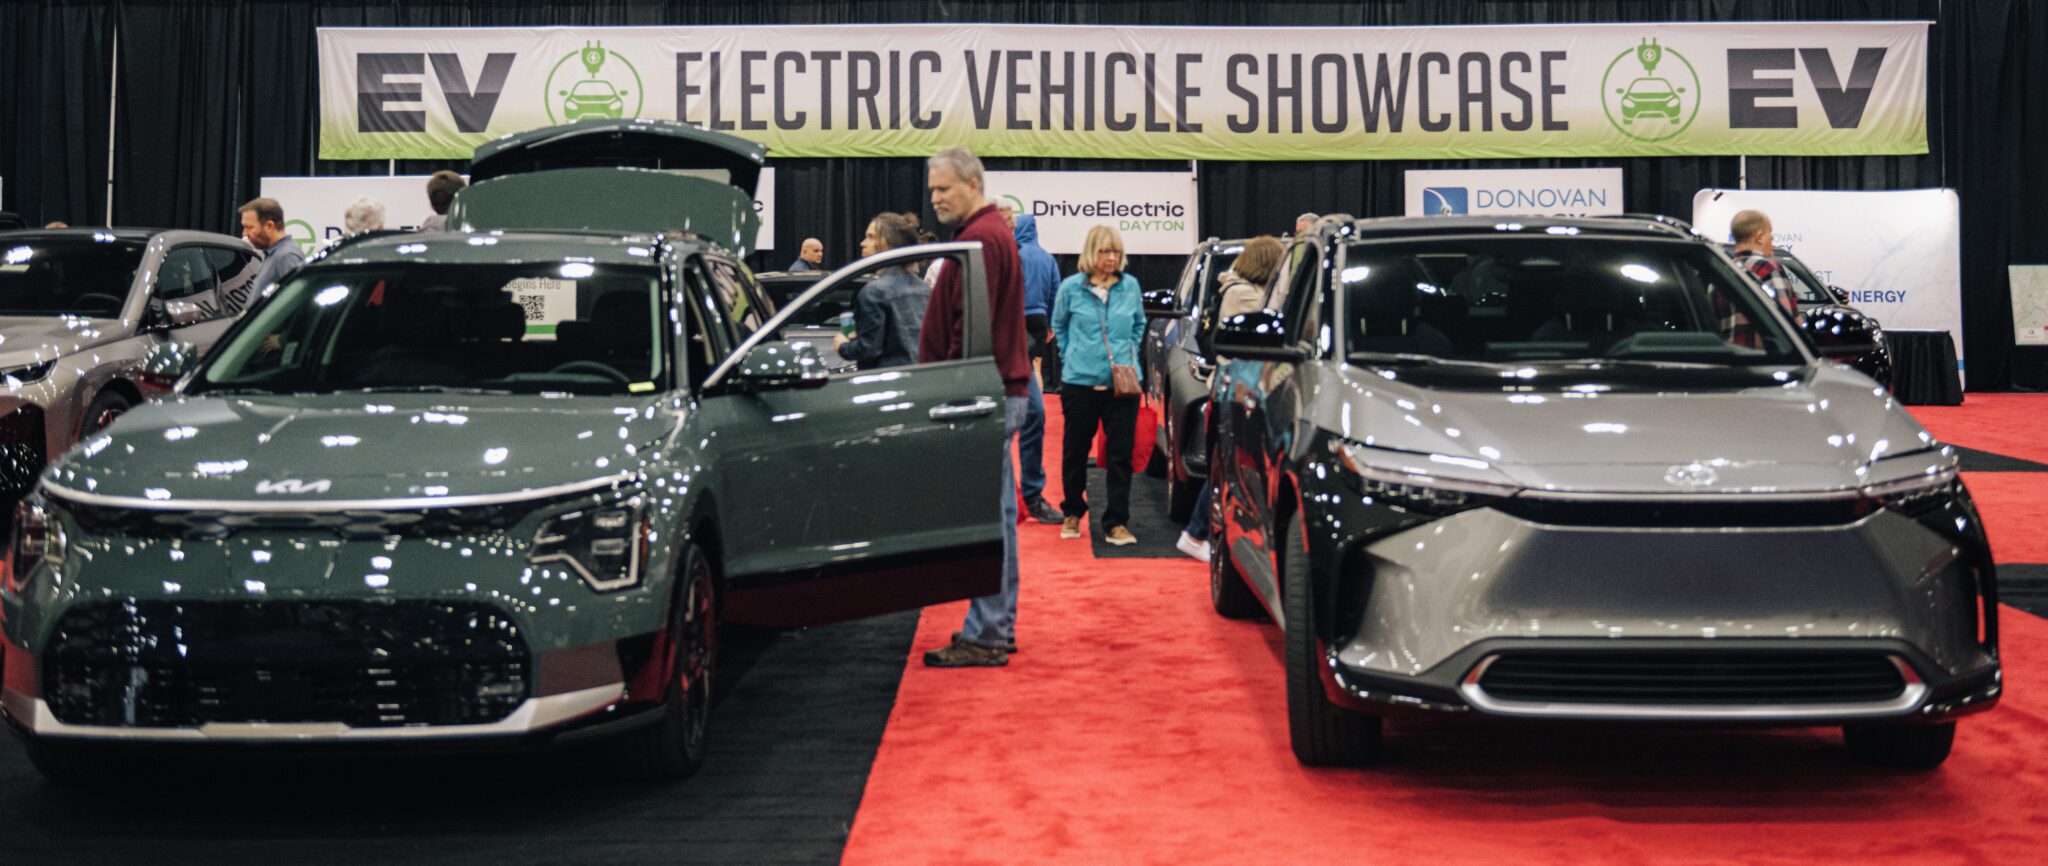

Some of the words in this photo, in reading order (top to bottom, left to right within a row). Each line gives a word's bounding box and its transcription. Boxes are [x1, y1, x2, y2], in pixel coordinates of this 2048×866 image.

[357, 53, 517, 133] EV
[676, 50, 941, 131] ELECTRIC
[964, 50, 1203, 133] VEHICLE
[1226, 50, 1569, 134] SHOWCASE
[1727, 47, 1888, 129] EV
[1477, 189, 1606, 208] DONOVAN
[1032, 200, 1184, 217] DriveElectric
[1119, 220, 1185, 231] DAYTON
[1773, 233, 1802, 243] OVAN
[540, 279, 562, 290] Here
[1849, 290, 1906, 303] NERGY
